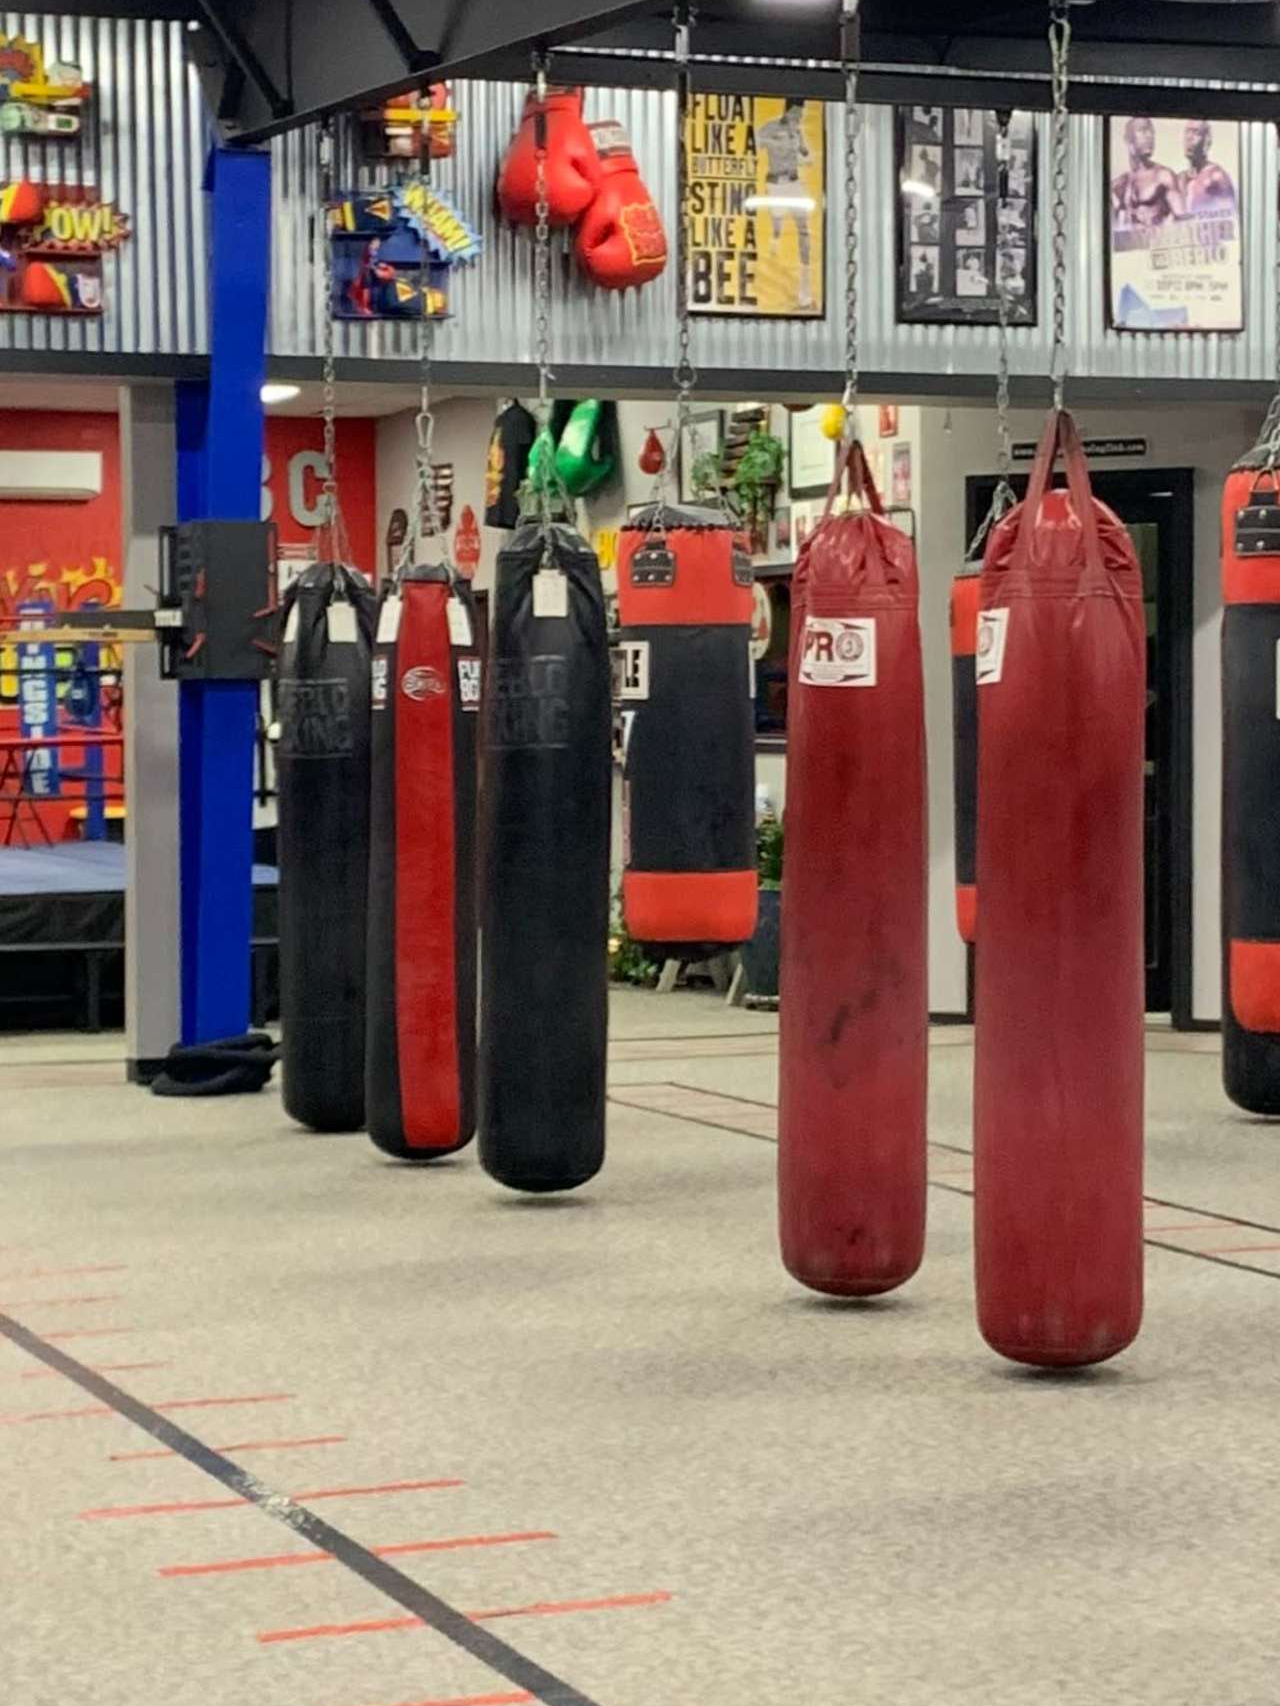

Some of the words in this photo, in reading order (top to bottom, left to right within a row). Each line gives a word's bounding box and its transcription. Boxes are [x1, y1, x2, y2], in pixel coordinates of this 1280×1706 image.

[690, 92, 755, 123] FLOAT
[690, 122, 736, 155] LIKE
[744, 125, 757, 155] A
[691, 156, 758, 178] BUTTERFLY
[691, 181, 757, 217] STING
[690, 216, 736, 249] LIKE
[744, 219, 757, 249] A
[692, 250, 758, 306] BEE
